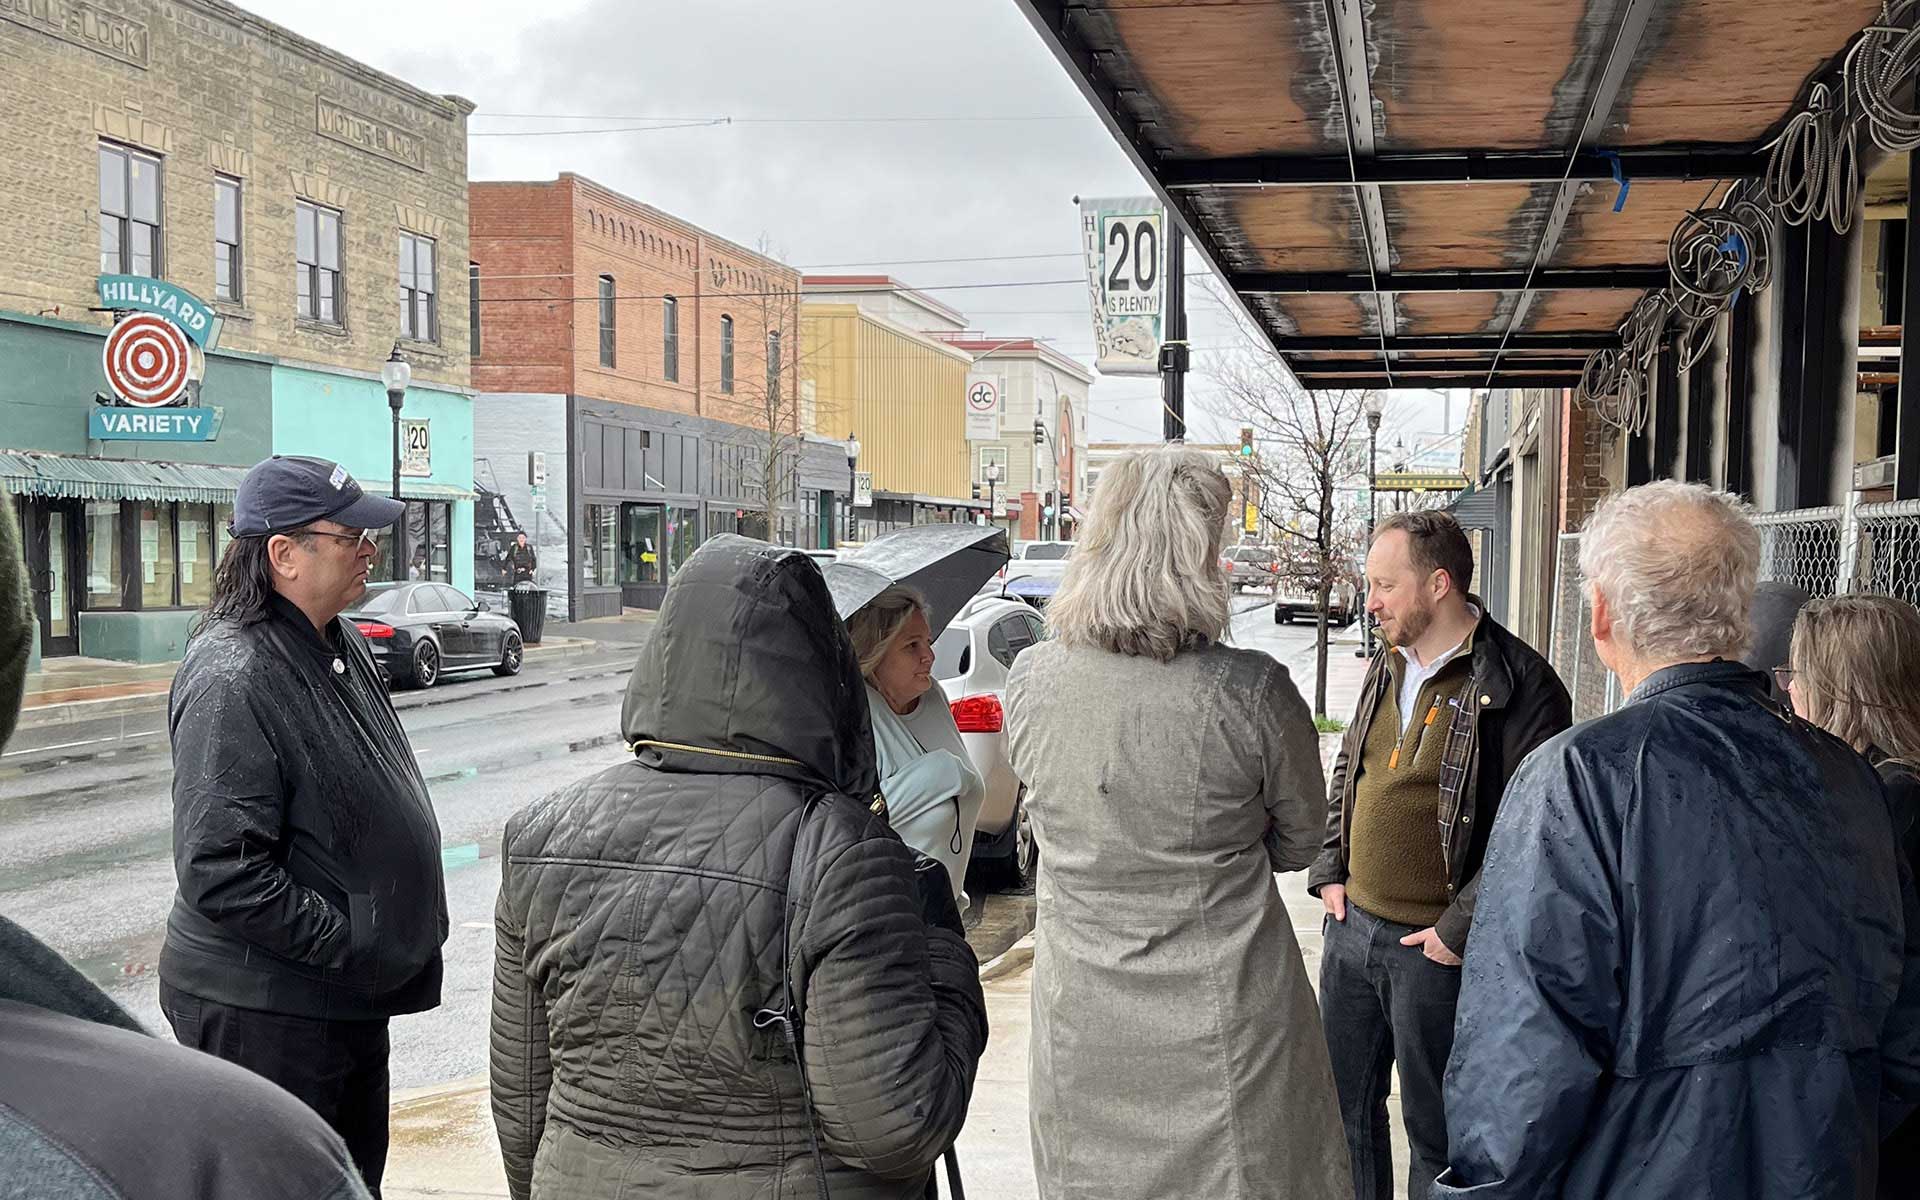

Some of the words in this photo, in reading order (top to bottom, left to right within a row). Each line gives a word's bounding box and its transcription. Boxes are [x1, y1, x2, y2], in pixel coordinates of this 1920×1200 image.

[1109, 220, 1156, 291] 20
[1084, 215, 1108, 359] HILLYARD
[102, 282, 206, 330] HILLYARD
[1109, 297, 1116, 312] IS
[1119, 296, 1157, 312] PLENTY!
[972, 385, 992, 403] dc
[101, 413, 202, 434] VARIETY
[410, 426, 428, 449] 20
[860, 477, 870, 490] 20
